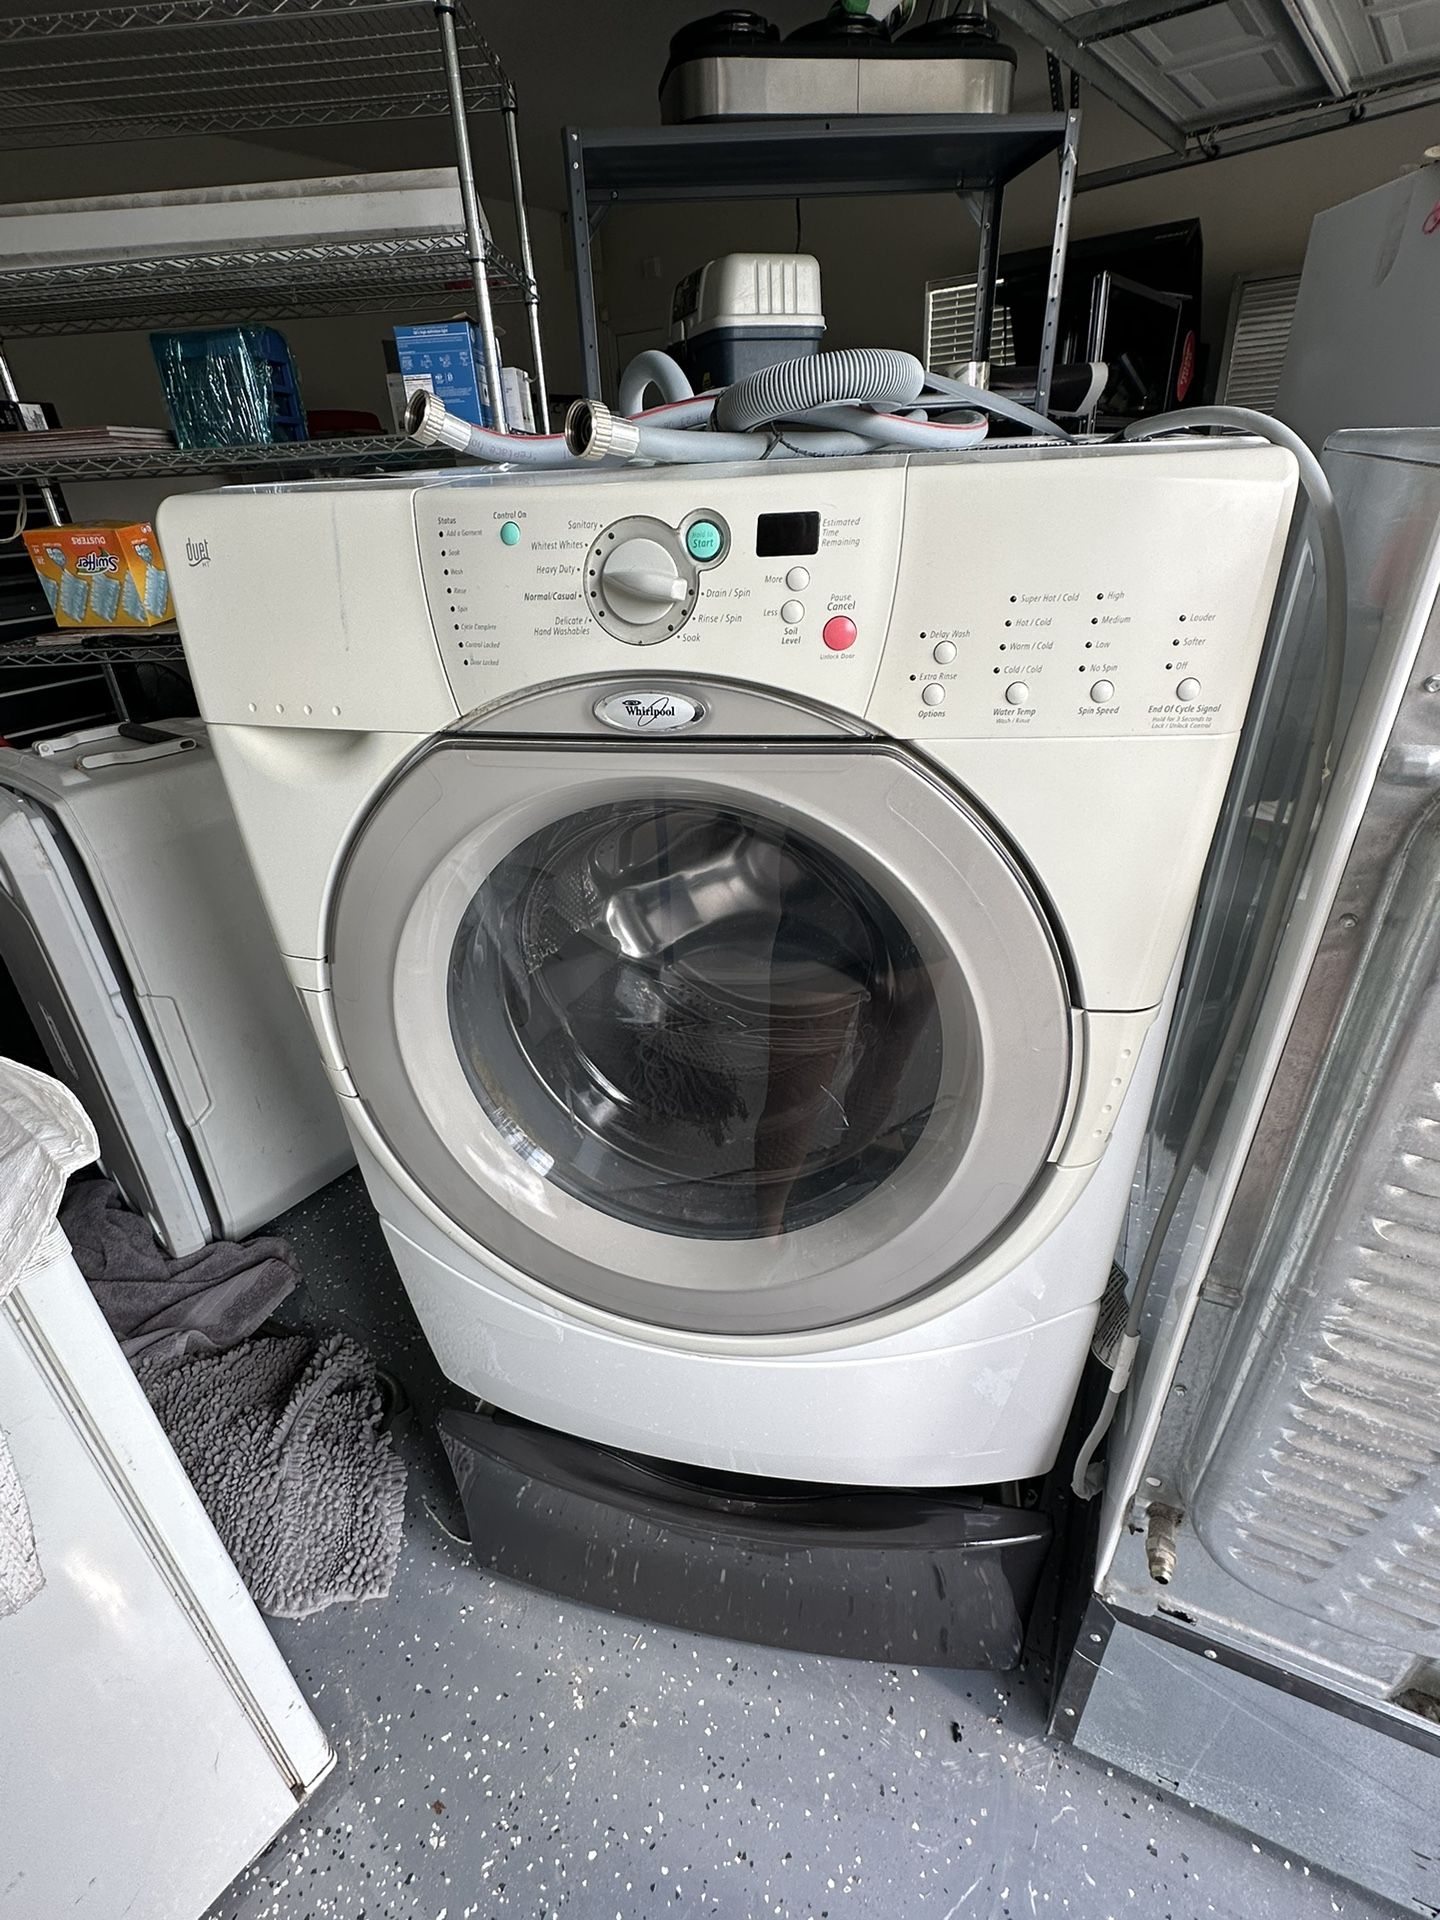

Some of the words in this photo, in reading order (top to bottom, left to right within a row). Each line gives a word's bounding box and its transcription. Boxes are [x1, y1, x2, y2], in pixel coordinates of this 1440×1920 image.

[493, 511, 516, 519] Control
[517, 510, 527, 519] On
[437, 516, 457, 525] Status
[567, 520, 598, 531] Sanitary
[822, 517, 861, 527] Estimated
[461, 529, 483, 537] Garment
[71, 536, 106, 545] DUSTERS
[531, 541, 558, 550] Whitest
[559, 540, 584, 550] Whites
[693, 538, 714, 549] Start
[821, 537, 861, 548] Remaining
[186, 537, 209, 562] duet
[448, 549, 460, 557] Soak
[77, 553, 119, 572] Swiffer
[536, 565, 558, 576] Heavy
[559, 564, 576, 576] Duty
[764, 575, 783, 583] More
[706, 588, 727, 598] Drain
[734, 588, 751, 600] Spin
[830, 594, 852, 602] Pause
[1020, 594, 1042, 604] Super
[1042, 594, 1056, 602] Hot
[1062, 593, 1080, 602] Cold
[1107, 591, 1125, 602] High
[826, 601, 856, 611] Cancel
[763, 608, 778, 616] Less
[555, 616, 583, 626] Delicate
[698, 614, 720, 623] Rinse
[725, 614, 742, 625] Spin
[1015, 618, 1029, 627] Hot
[1034, 618, 1052, 626] Cold
[1101, 615, 1132, 624] Medium
[1190, 613, 1216, 622] Louder
[460, 622, 473, 632] Cycle
[474, 623, 497, 631] Complete
[534, 627, 552, 636] Hand
[553, 626, 590, 636] Washables
[784, 627, 798, 636] Soil
[682, 633, 700, 642] Soak
[930, 630, 950, 640] Delay
[952, 630, 971, 638] Wash
[484, 640, 500, 648] Locked
[781, 636, 801, 645] Level
[1183, 638, 1207, 646] Softer
[1010, 642, 1031, 651] Warm
[1036, 642, 1054, 650] Cold
[820, 652, 840, 660] Unlock
[840, 652, 856, 660] Door
[470, 658, 482, 666] Door
[482, 658, 500, 666] Locked
[1176, 661, 1188, 670] Off
[1003, 666, 1020, 674] Cold
[1026, 665, 1043, 674] Cold
[1090, 664, 1101, 672] No
[1102, 664, 1118, 674] Spin
[919, 673, 938, 681] Extra
[938, 672, 958, 680] Rinse
[626, 705, 675, 719] Whirlpool
[993, 708, 1016, 717] Water
[1016, 708, 1036, 718] Temp
[1078, 706, 1095, 716] Spin
[1096, 706, 1120, 716] Speed
[1148, 704, 1164, 714] End
[1164, 704, 1174, 713] Of
[1174, 704, 1196, 715] Cycle
[1196, 704, 1222, 715] Signal
[918, 710, 946, 720] Options
